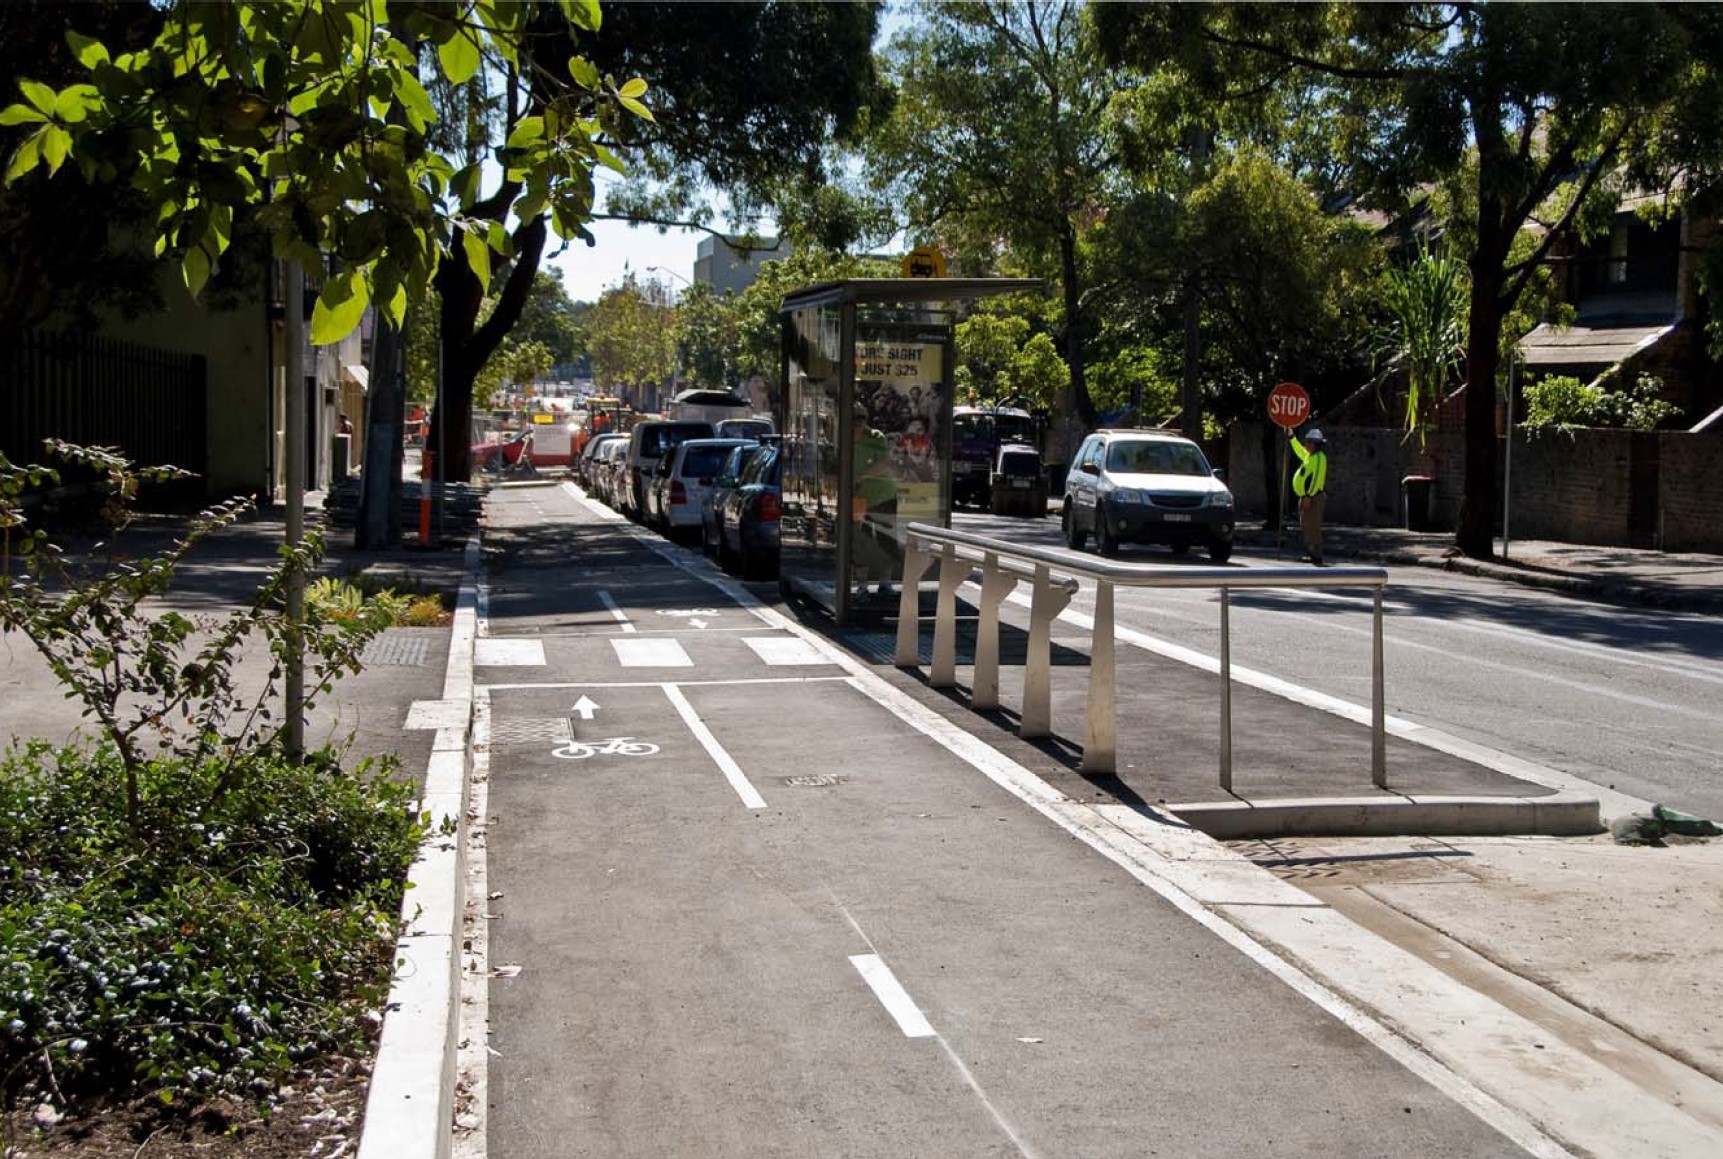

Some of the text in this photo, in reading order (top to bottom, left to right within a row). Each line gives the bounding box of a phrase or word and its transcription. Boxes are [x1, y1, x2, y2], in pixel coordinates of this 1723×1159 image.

[888, 348, 923, 360] SIGHT
[861, 363, 918, 377] JUST $25
[1271, 394, 1306, 417] STOP
